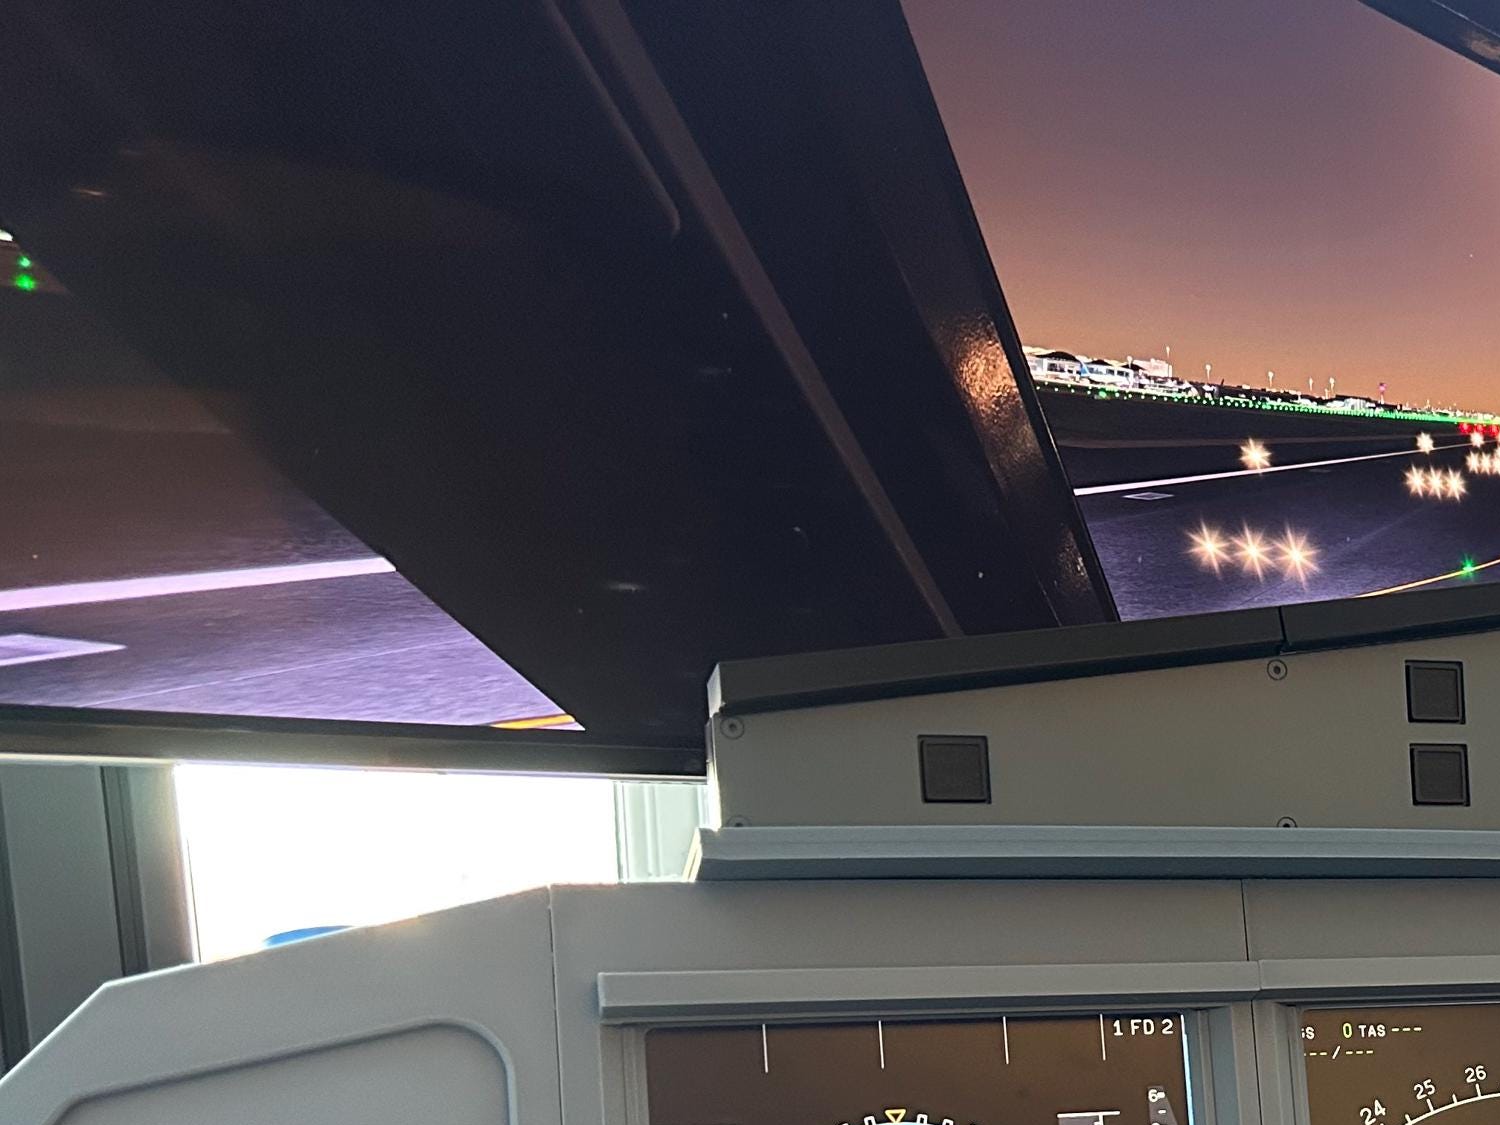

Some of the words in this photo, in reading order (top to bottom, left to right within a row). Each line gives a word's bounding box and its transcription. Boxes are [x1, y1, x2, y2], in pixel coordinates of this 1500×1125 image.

[1113, 1020, 1123, 1035] 1
[1131, 1020, 1155, 1035] FD
[1162, 1019, 1173, 1034] 2
[1343, 1023, 1352, 1038] 0
[1465, 1066, 1487, 1083] 26
[1414, 1079, 1436, 1099] 25
[1360, 1100, 1386, 1125] 24
